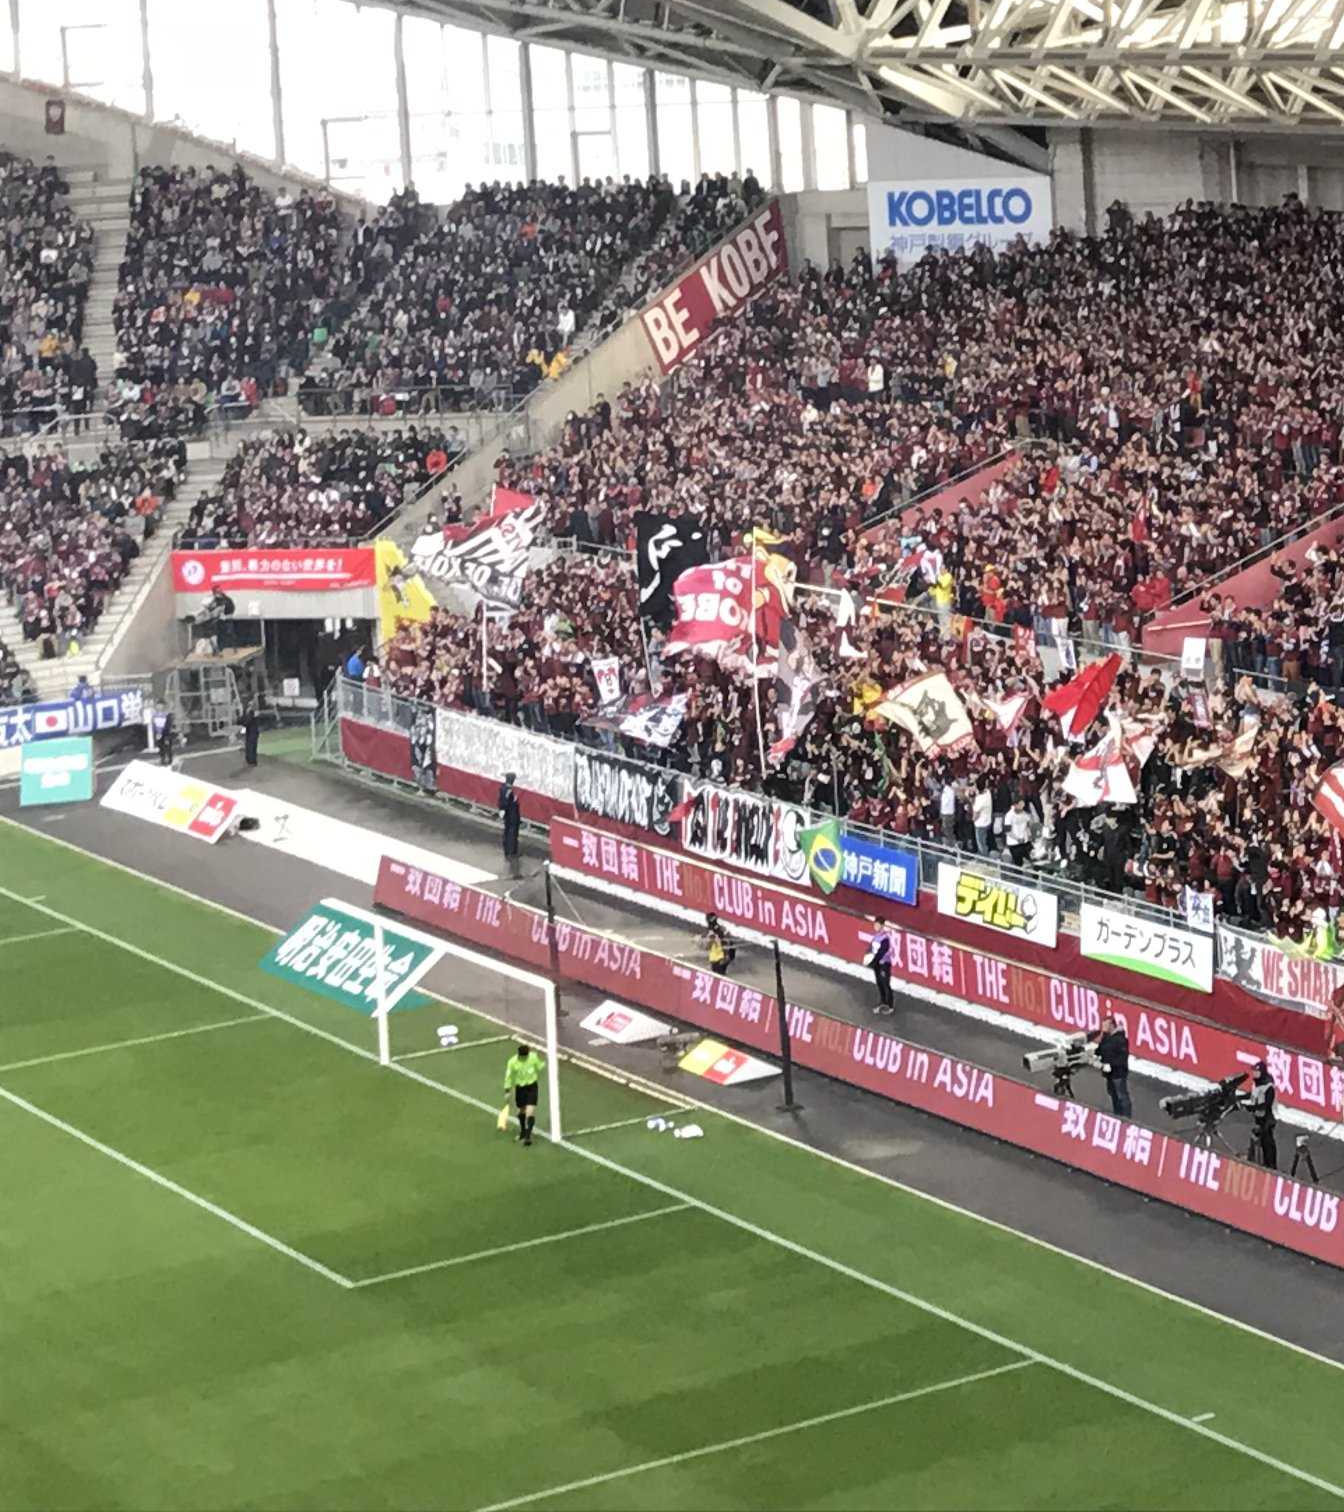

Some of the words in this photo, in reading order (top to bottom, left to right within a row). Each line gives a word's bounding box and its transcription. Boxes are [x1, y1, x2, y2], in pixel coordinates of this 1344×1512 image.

[887, 188, 1032, 227] KOBELCO
[643, 288, 700, 365] BE
[562, 829, 640, 883] 一致団結
[653, 853, 684, 897] THE
[713, 874, 754, 920] CLUB
[757, 886, 776, 927] in
[780, 898, 830, 945] ASIA
[842, 849, 908, 898] 神戸新聞
[594, 934, 642, 980] ASIA
[1096, 918, 1196, 969] ガーデンプラス
[1261, 947, 1284, 992] WE
[972, 954, 1010, 1006] THE
[1049, 978, 1101, 1032] CLUB
[1135, 1012, 1199, 1065] ASIA
[852, 1028, 903, 1075] CLUB
[906, 1050, 930, 1084] in
[933, 1057, 995, 1108] ASIA
[1178, 1143, 1221, 1193] THE
[1272, 1176, 1339, 1233] CLUB
